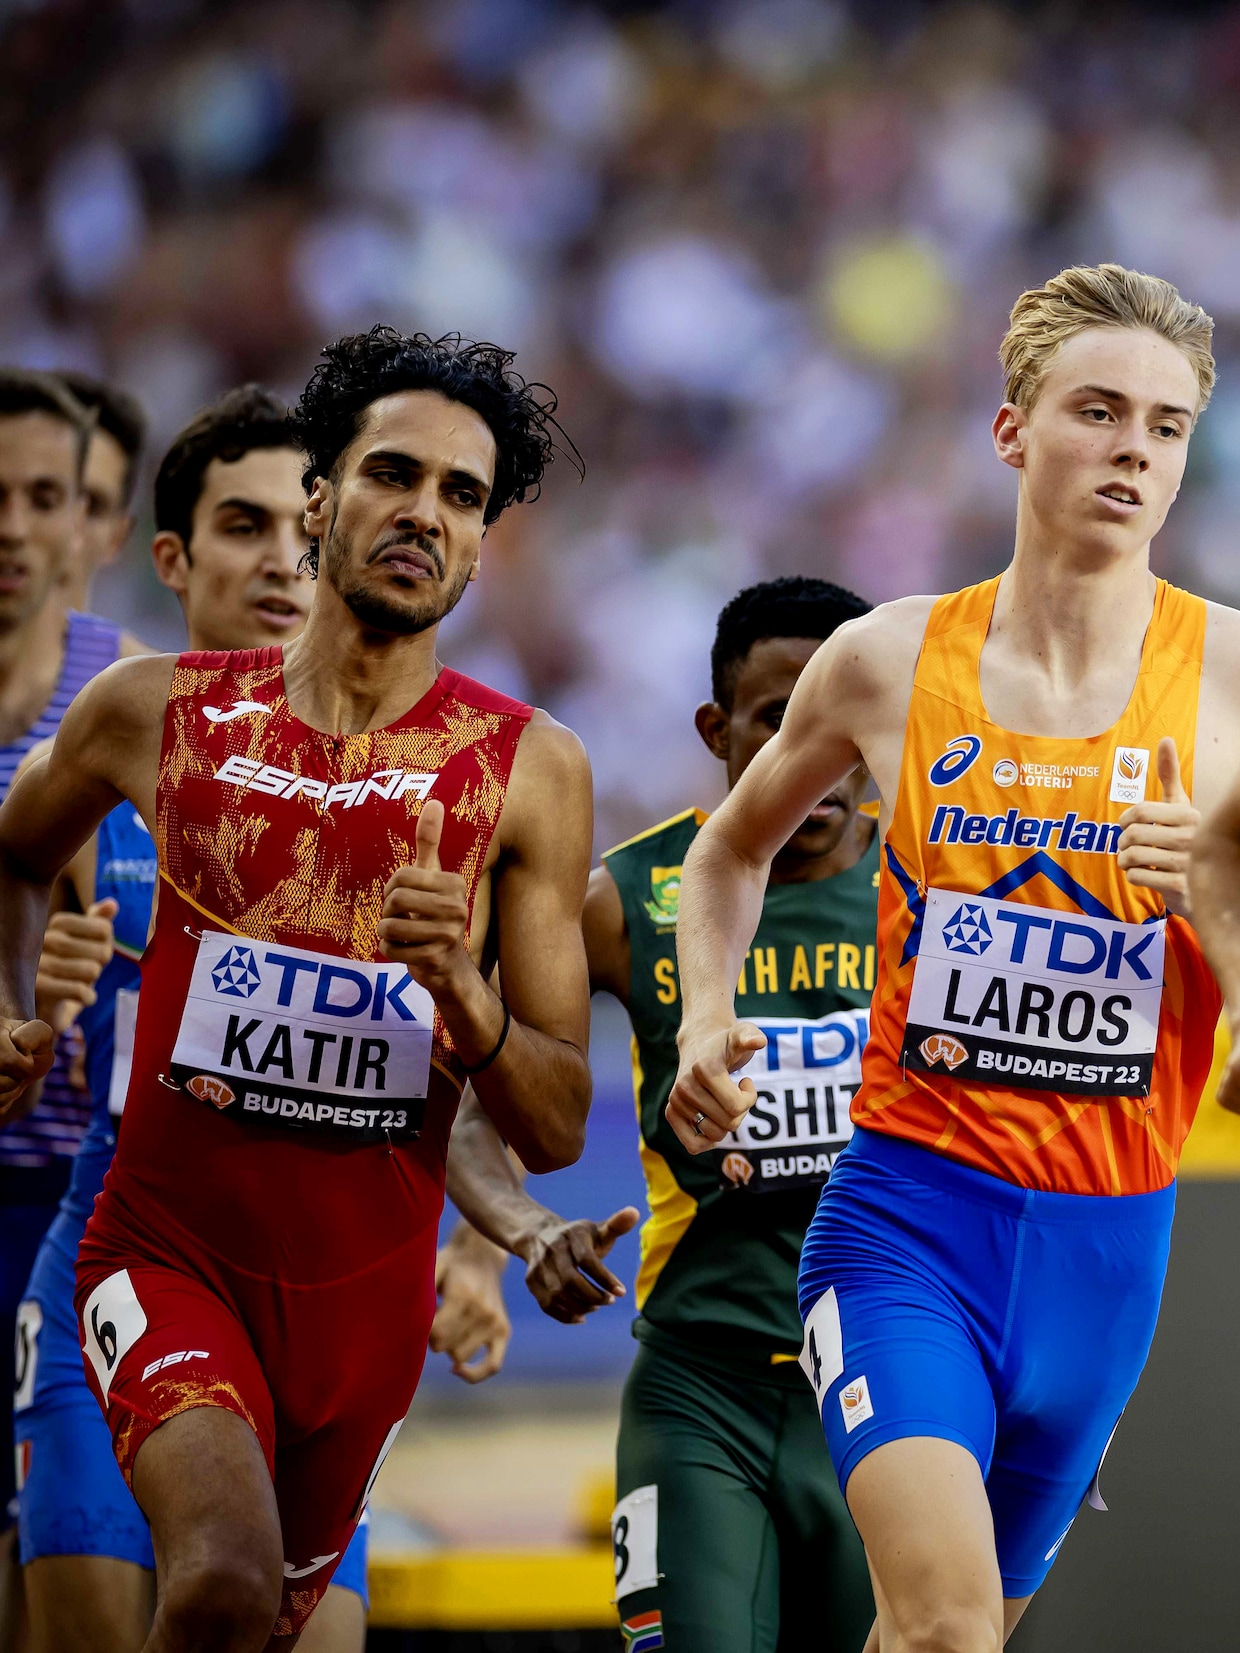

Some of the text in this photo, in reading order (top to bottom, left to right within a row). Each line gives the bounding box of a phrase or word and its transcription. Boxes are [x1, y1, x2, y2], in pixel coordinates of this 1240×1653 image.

[213, 755, 439, 811] ESPAÑA
[1019, 763, 1100, 777] NEDERLANDSE
[1019, 775, 1073, 789] LOTERIJ
[1116, 783, 1140, 791] TeamNL
[927, 804, 1124, 855] Nederlan
[789, 943, 876, 992] AFRI
[996, 909, 1157, 981] TDK
[264, 952, 418, 1022] TDK
[943, 968, 1132, 1047] LAROS
[220, 1014, 390, 1091] KATIR
[976, 1049, 1141, 1084] BUDAPEST 23
[243, 1092, 407, 1128] BUDAPEST 23
[91, 1302, 117, 1371] 6
[808, 1325, 822, 1392] 4
[141, 1350, 210, 1382] ESP
